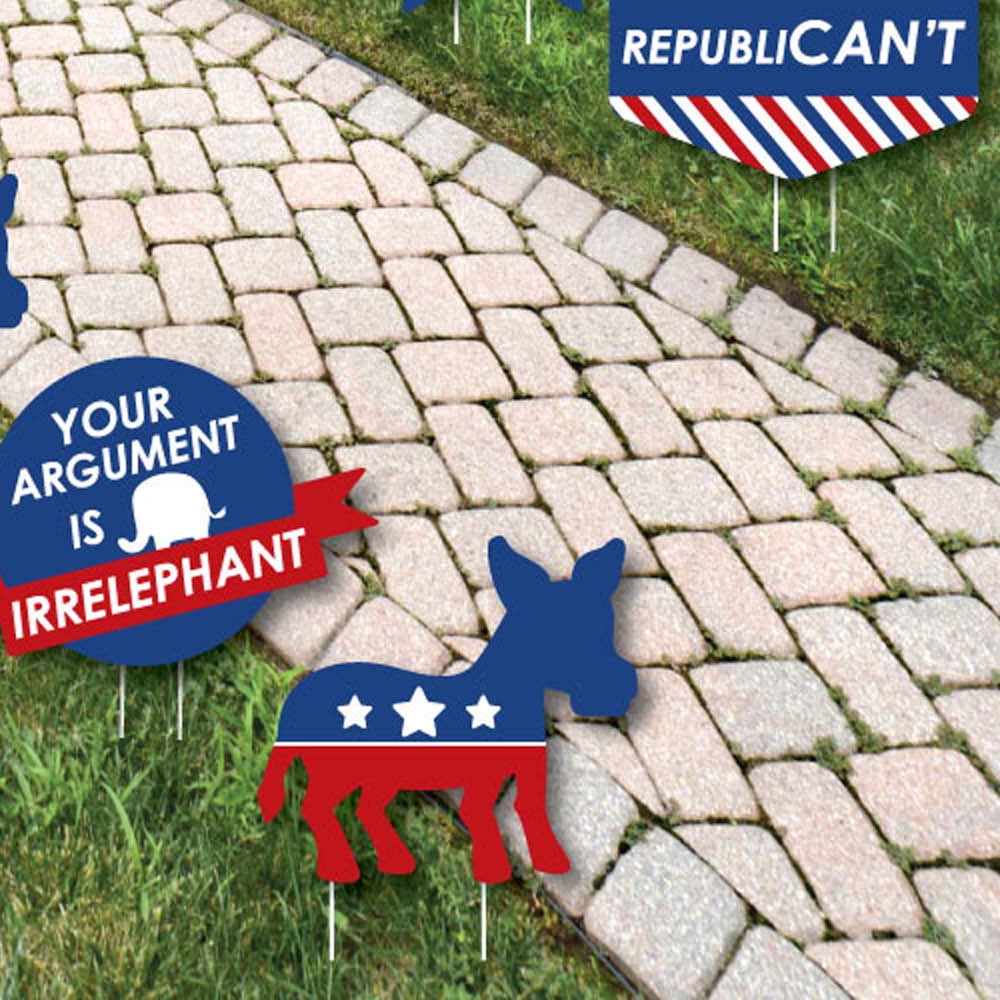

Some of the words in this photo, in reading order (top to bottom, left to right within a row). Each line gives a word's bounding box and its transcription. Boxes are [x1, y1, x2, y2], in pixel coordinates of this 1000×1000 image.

[622, 18, 966, 65] REPUBLICAN'T
[51, 385, 173, 445] YOUR
[10, 414, 239, 505] ARGUMENT
[69, 509, 104, 549] IS
[11, 527, 305, 639] IRRELEPHANT
